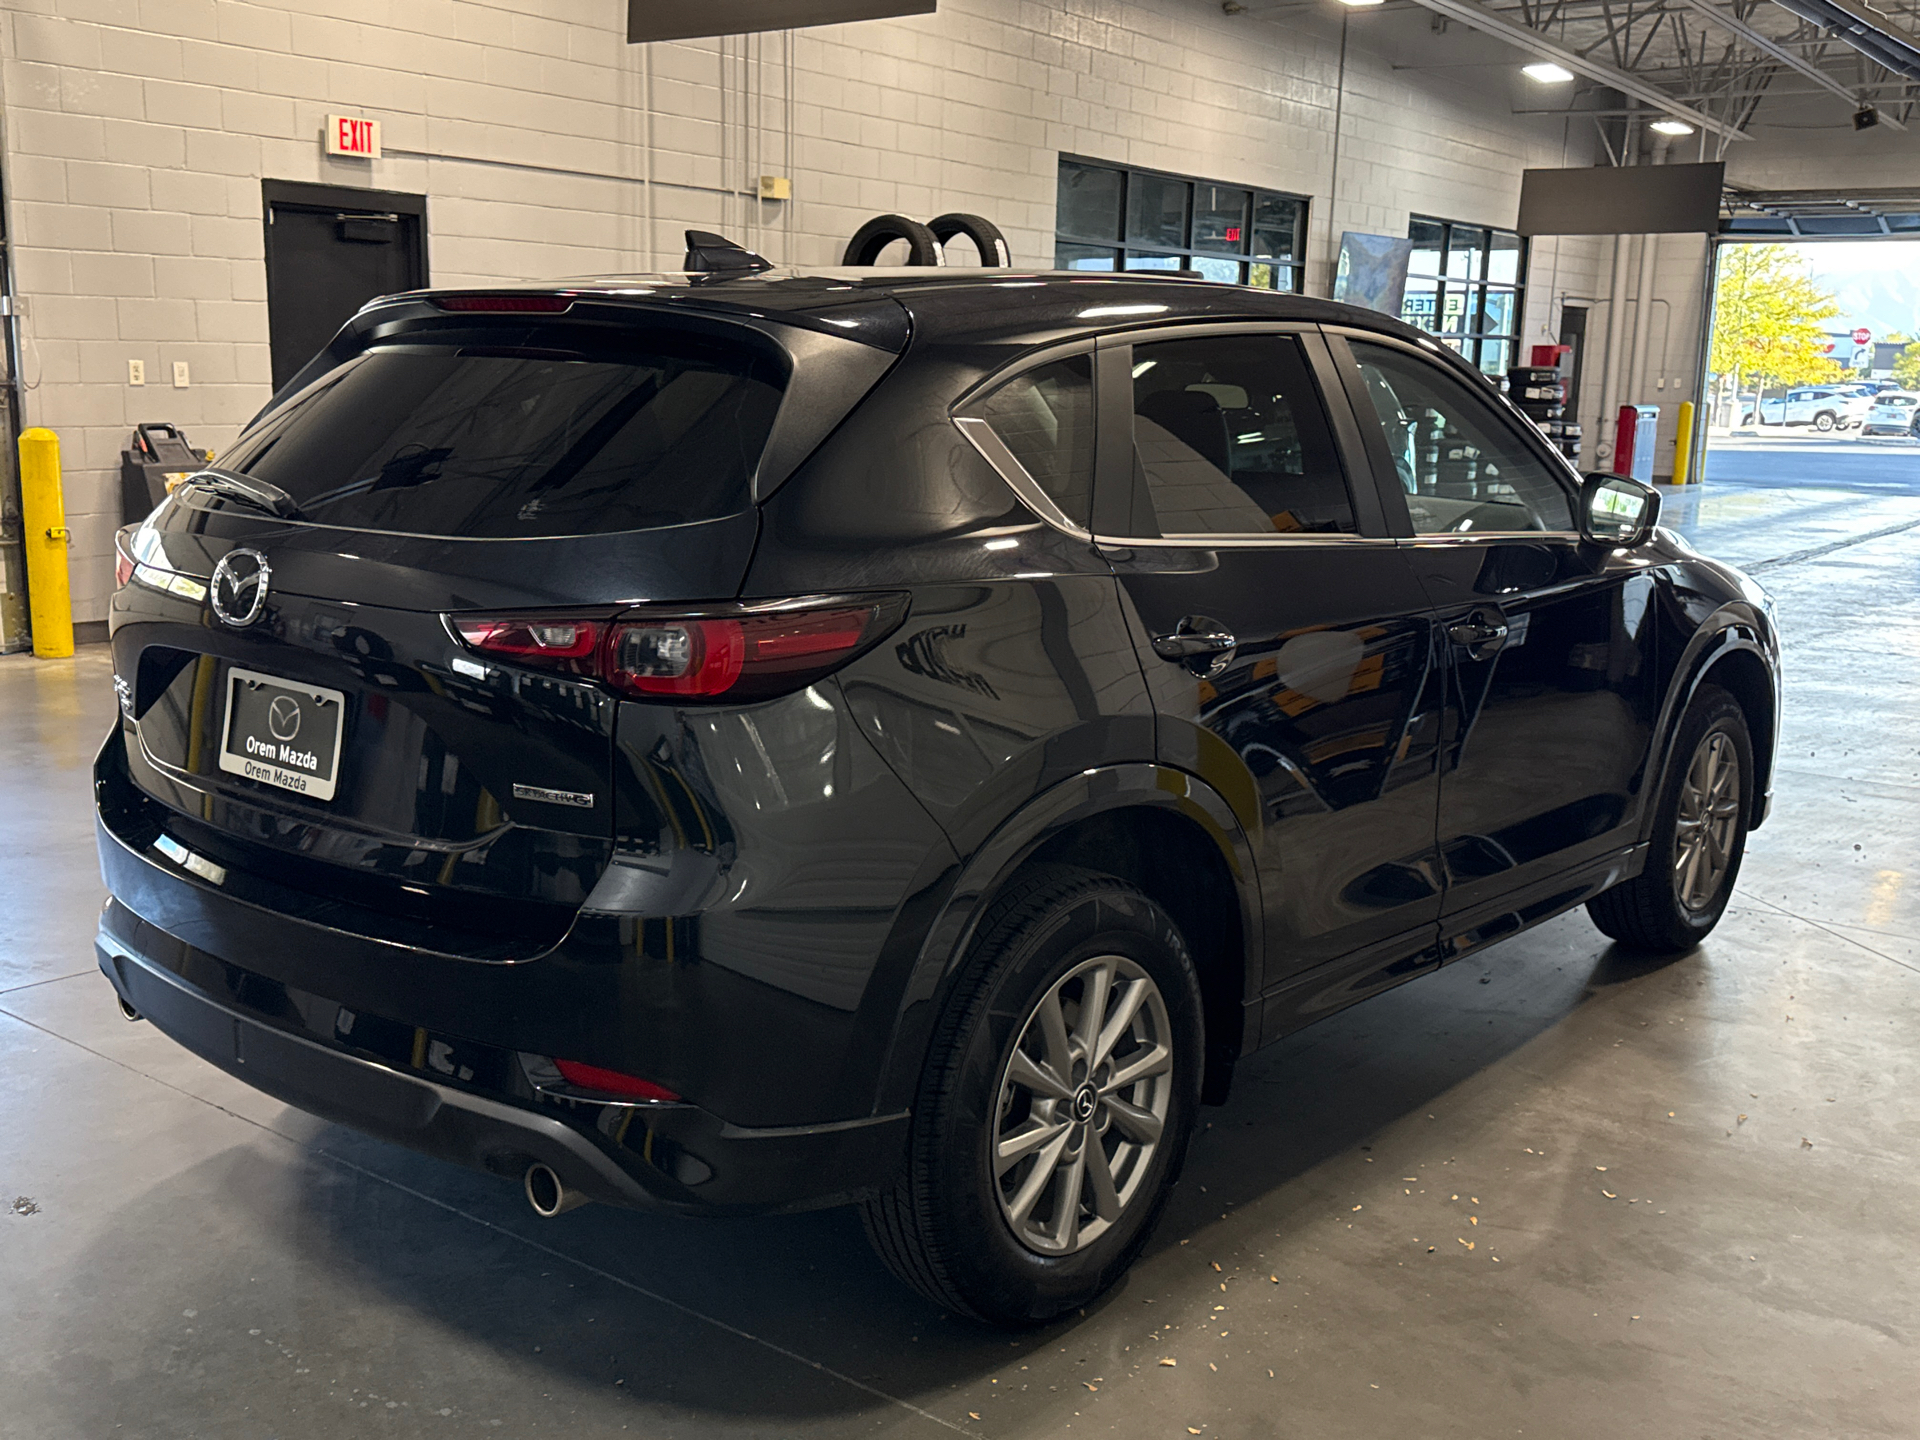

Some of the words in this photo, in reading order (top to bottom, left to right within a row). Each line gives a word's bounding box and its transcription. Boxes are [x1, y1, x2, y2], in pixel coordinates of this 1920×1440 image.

[339, 118, 373, 153] EXIT
[1852, 331, 1871, 341] STOP
[246, 735, 276, 760] Orem
[279, 744, 318, 771] Mazda
[244, 761, 271, 782] Orem
[273, 768, 308, 792] Mazda
